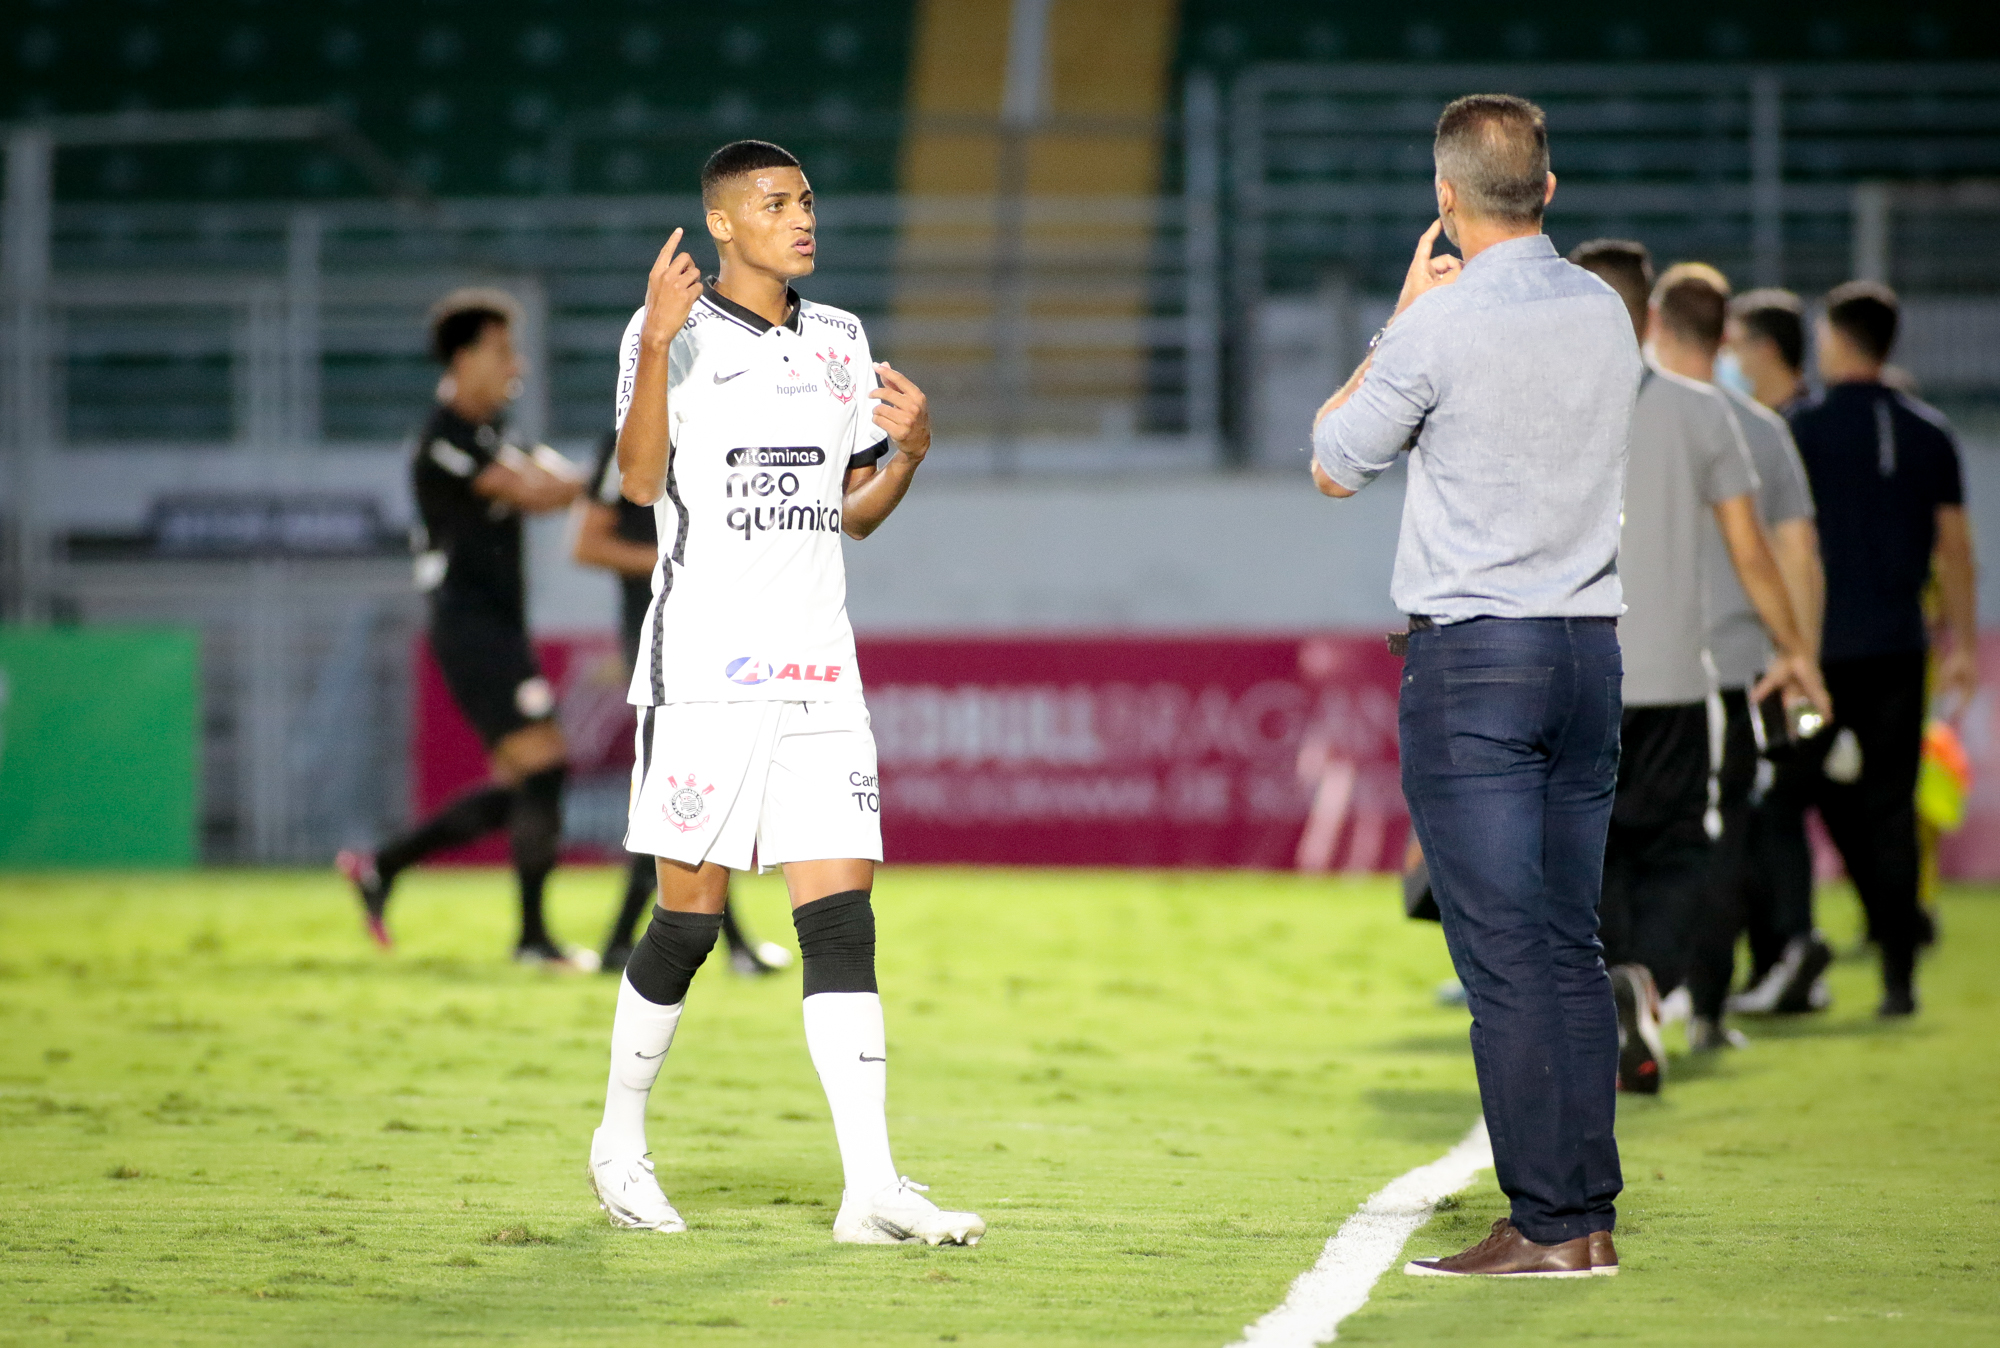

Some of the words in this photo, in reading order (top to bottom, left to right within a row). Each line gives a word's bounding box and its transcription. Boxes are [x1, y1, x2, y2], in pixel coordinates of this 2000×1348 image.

[815, 313, 857, 340] bmg
[776, 382, 818, 397] hapvida
[733, 449, 819, 464] vitaminas
[726, 472, 800, 498] neo
[726, 499, 840, 541] química
[774, 663, 842, 682] ALE
[849, 771, 879, 788] Cart
[851, 792, 880, 813] TO
